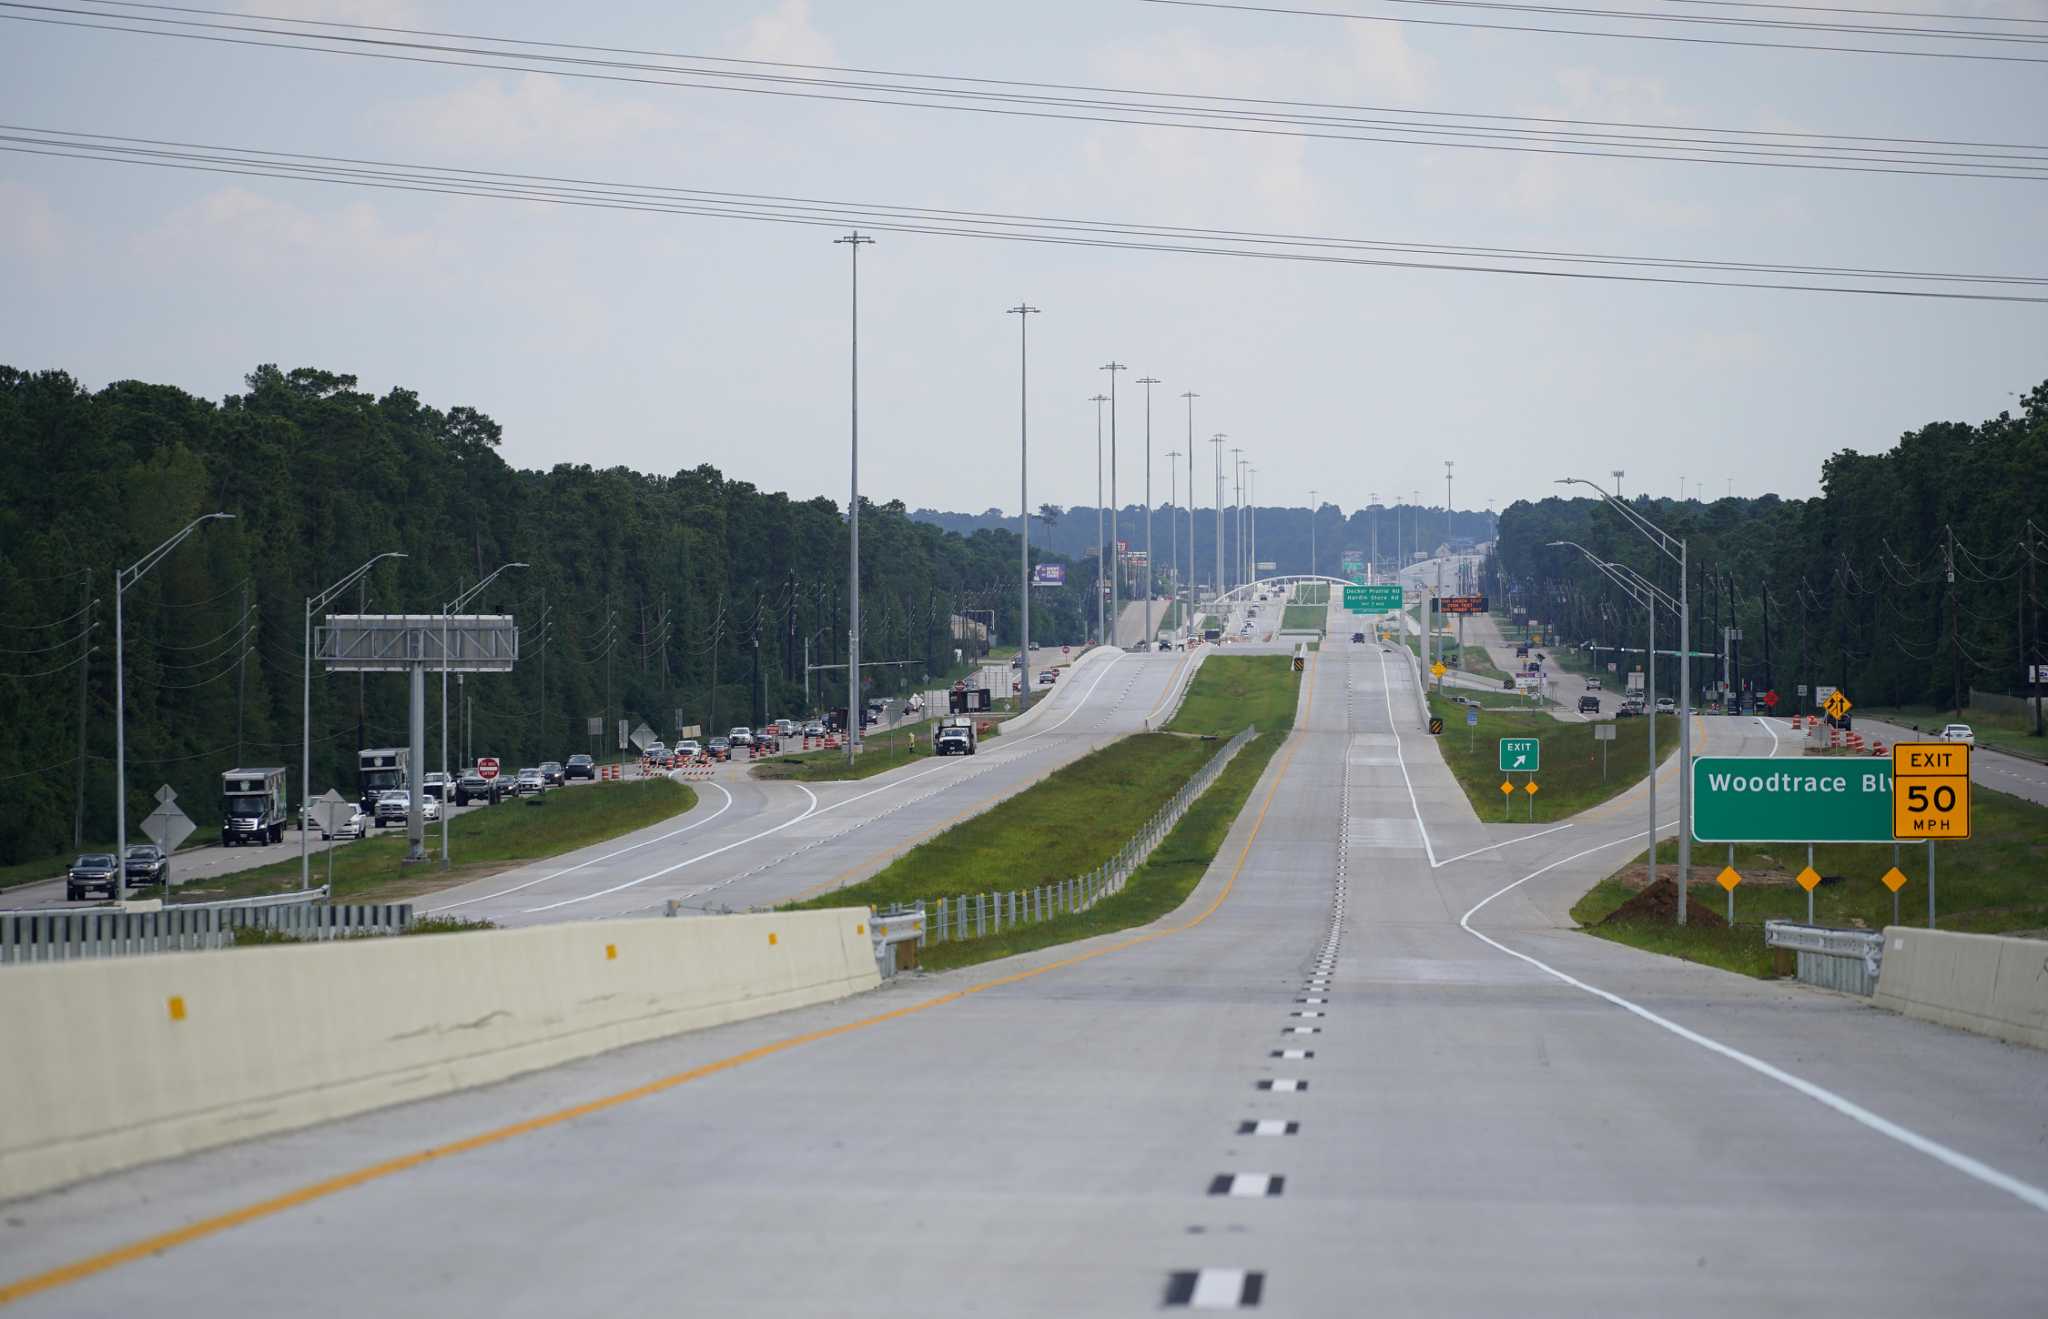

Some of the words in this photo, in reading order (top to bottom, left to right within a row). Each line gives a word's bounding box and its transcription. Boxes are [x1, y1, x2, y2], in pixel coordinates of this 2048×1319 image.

[1507, 743, 1532, 751] EXIT
[1911, 753, 1953, 767] EXIT
[1708, 772, 1847, 793] Woodtrace
[1908, 785, 1956, 812] 50
[1913, 819, 1950, 830] MPH
